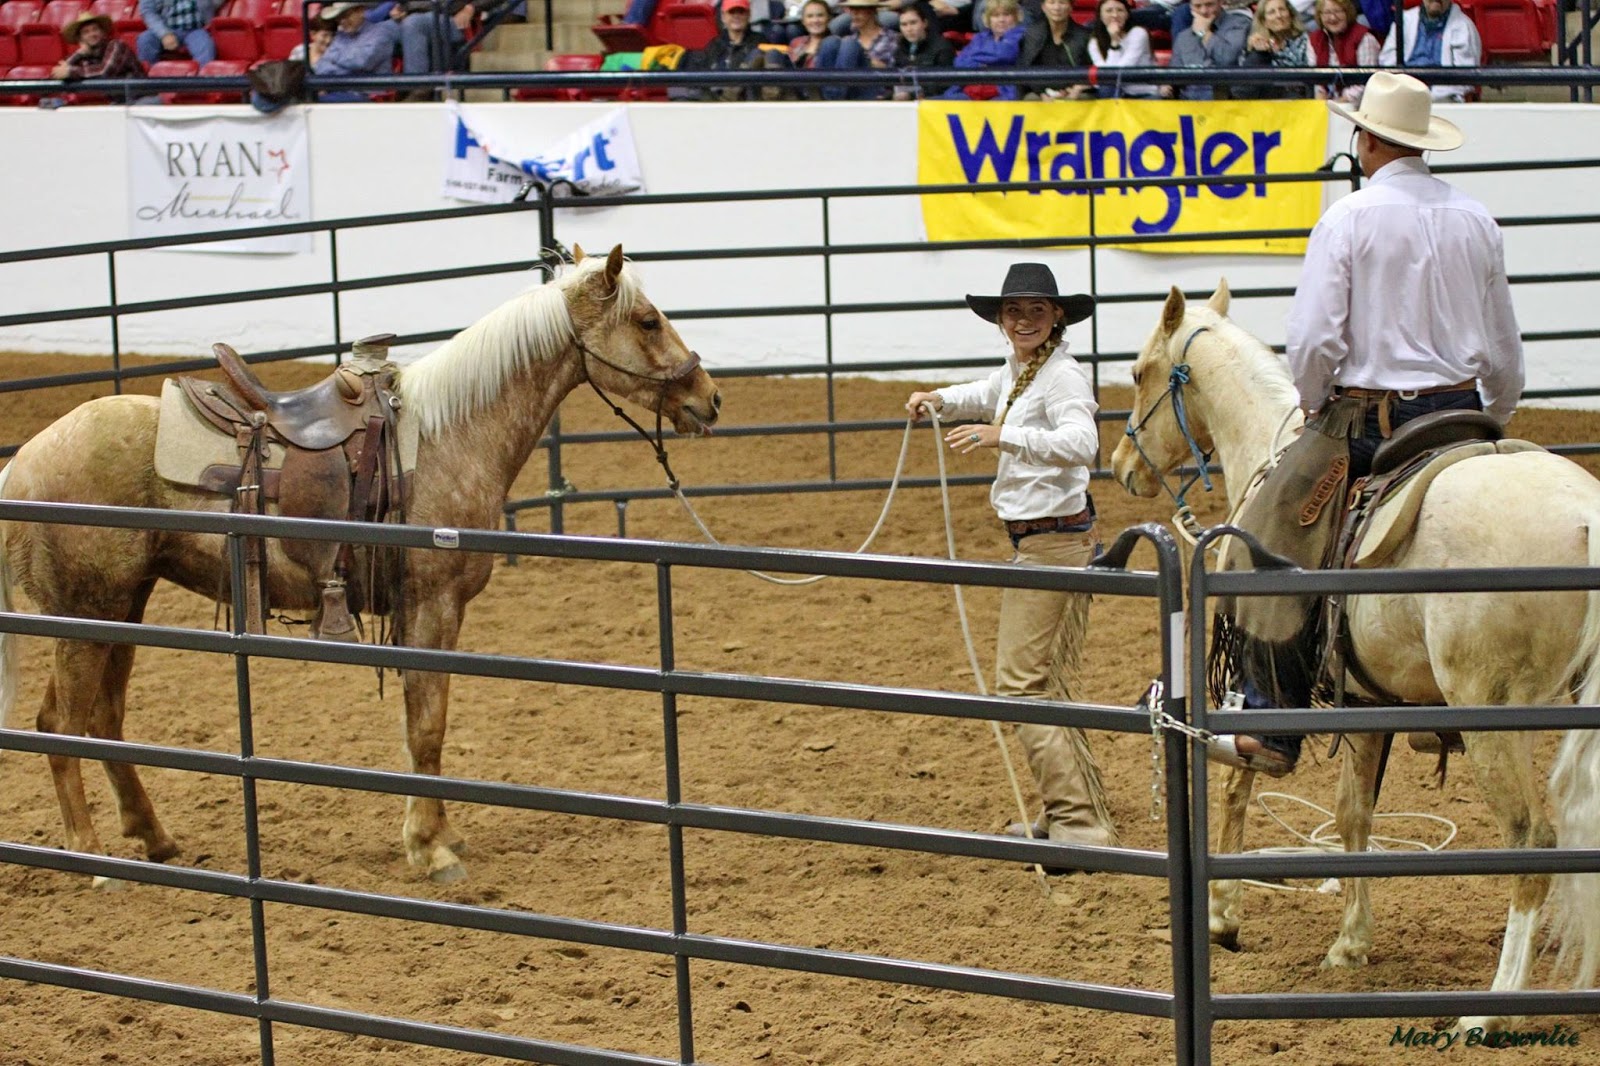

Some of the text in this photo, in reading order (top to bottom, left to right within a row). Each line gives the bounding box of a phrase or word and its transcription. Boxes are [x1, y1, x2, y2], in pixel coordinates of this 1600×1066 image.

[166, 141, 263, 177] RYAN
[946, 114, 1281, 235] Wrangler
[136, 182, 297, 223] Michael
